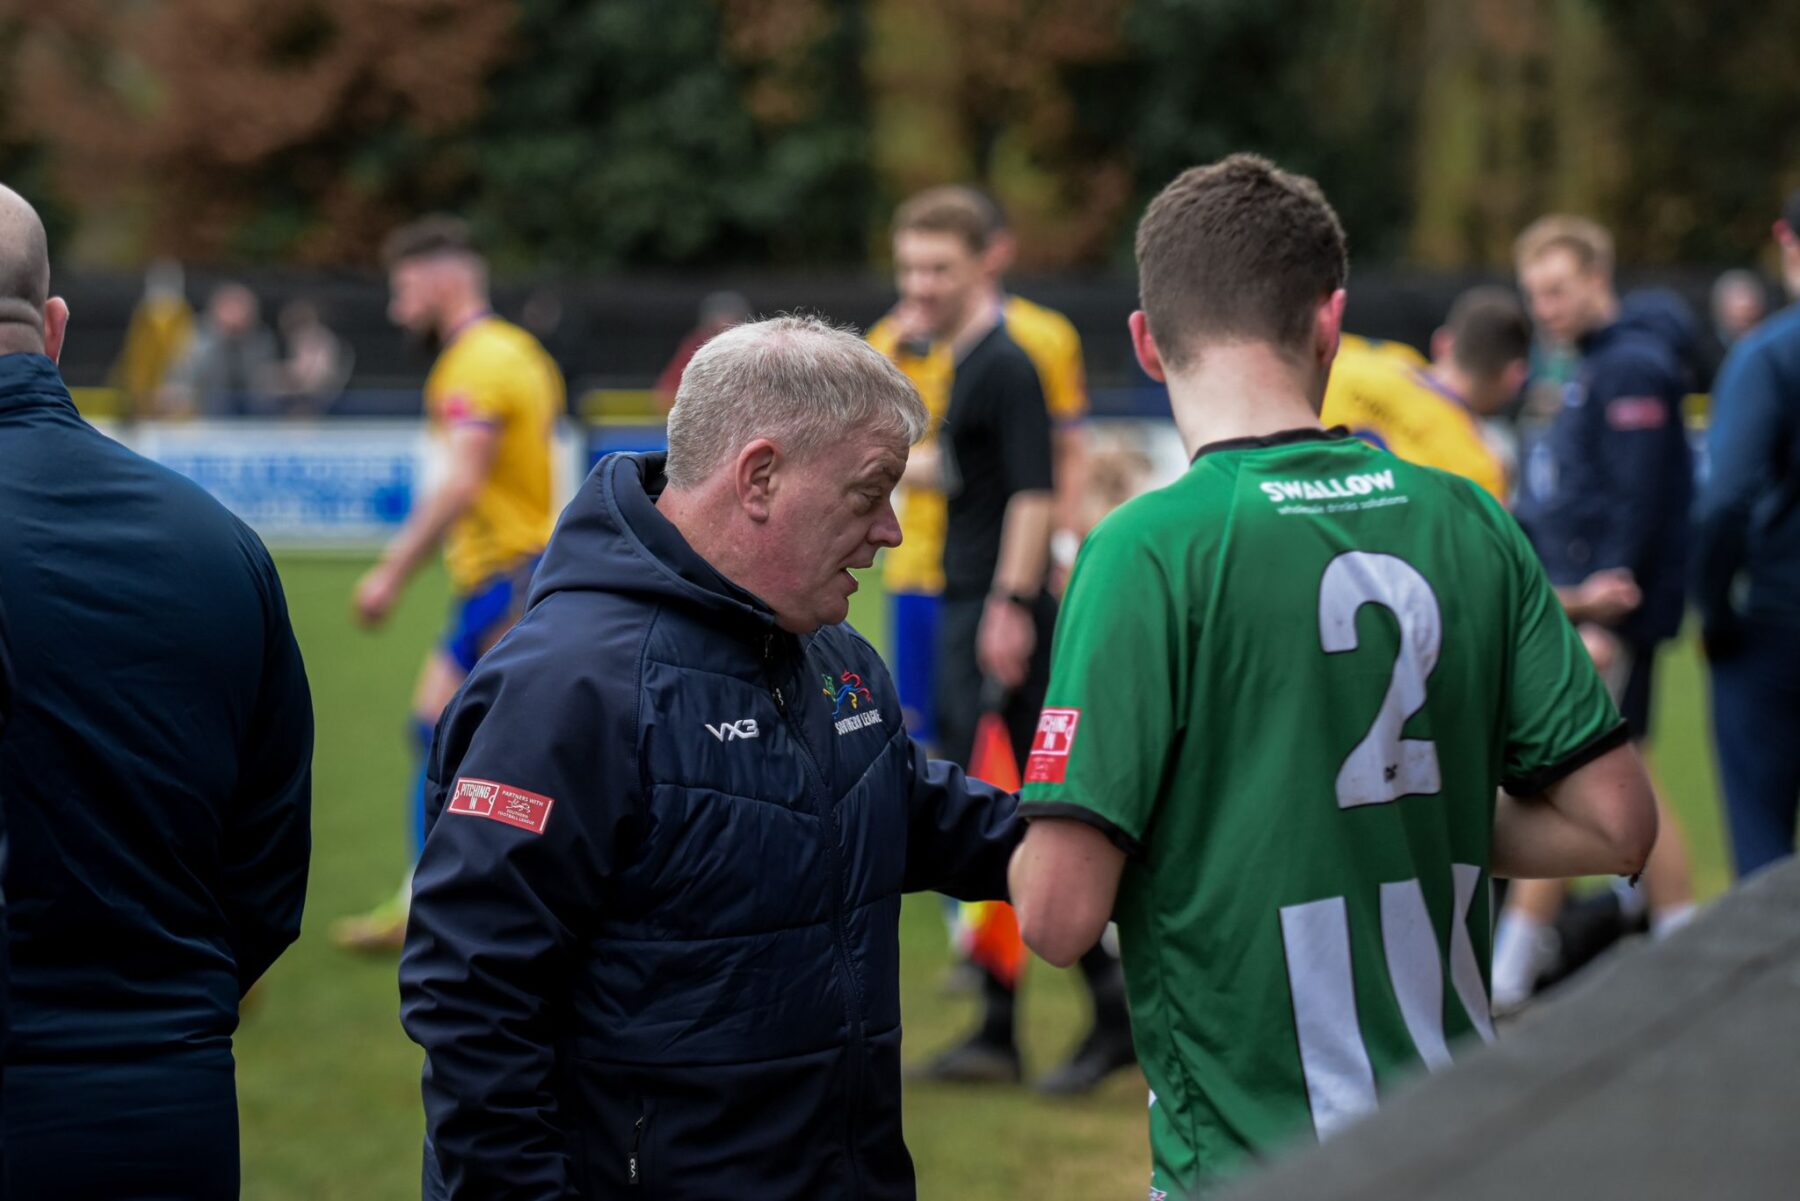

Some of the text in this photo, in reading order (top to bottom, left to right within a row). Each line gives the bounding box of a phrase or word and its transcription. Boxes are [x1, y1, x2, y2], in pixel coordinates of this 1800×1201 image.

[1260, 469, 1395, 502] SWALLOW
[1360, 495, 1408, 509] solutions
[1318, 551, 1442, 809] 2
[705, 719, 760, 742] VX3
[834, 709, 882, 736] SOUTHERN LEAGUE
[1043, 731, 1056, 750] IN
[460, 783, 491, 799] PITCHING
[502, 790, 544, 807] PARTNERS WITH
[469, 797, 477, 810] IN
